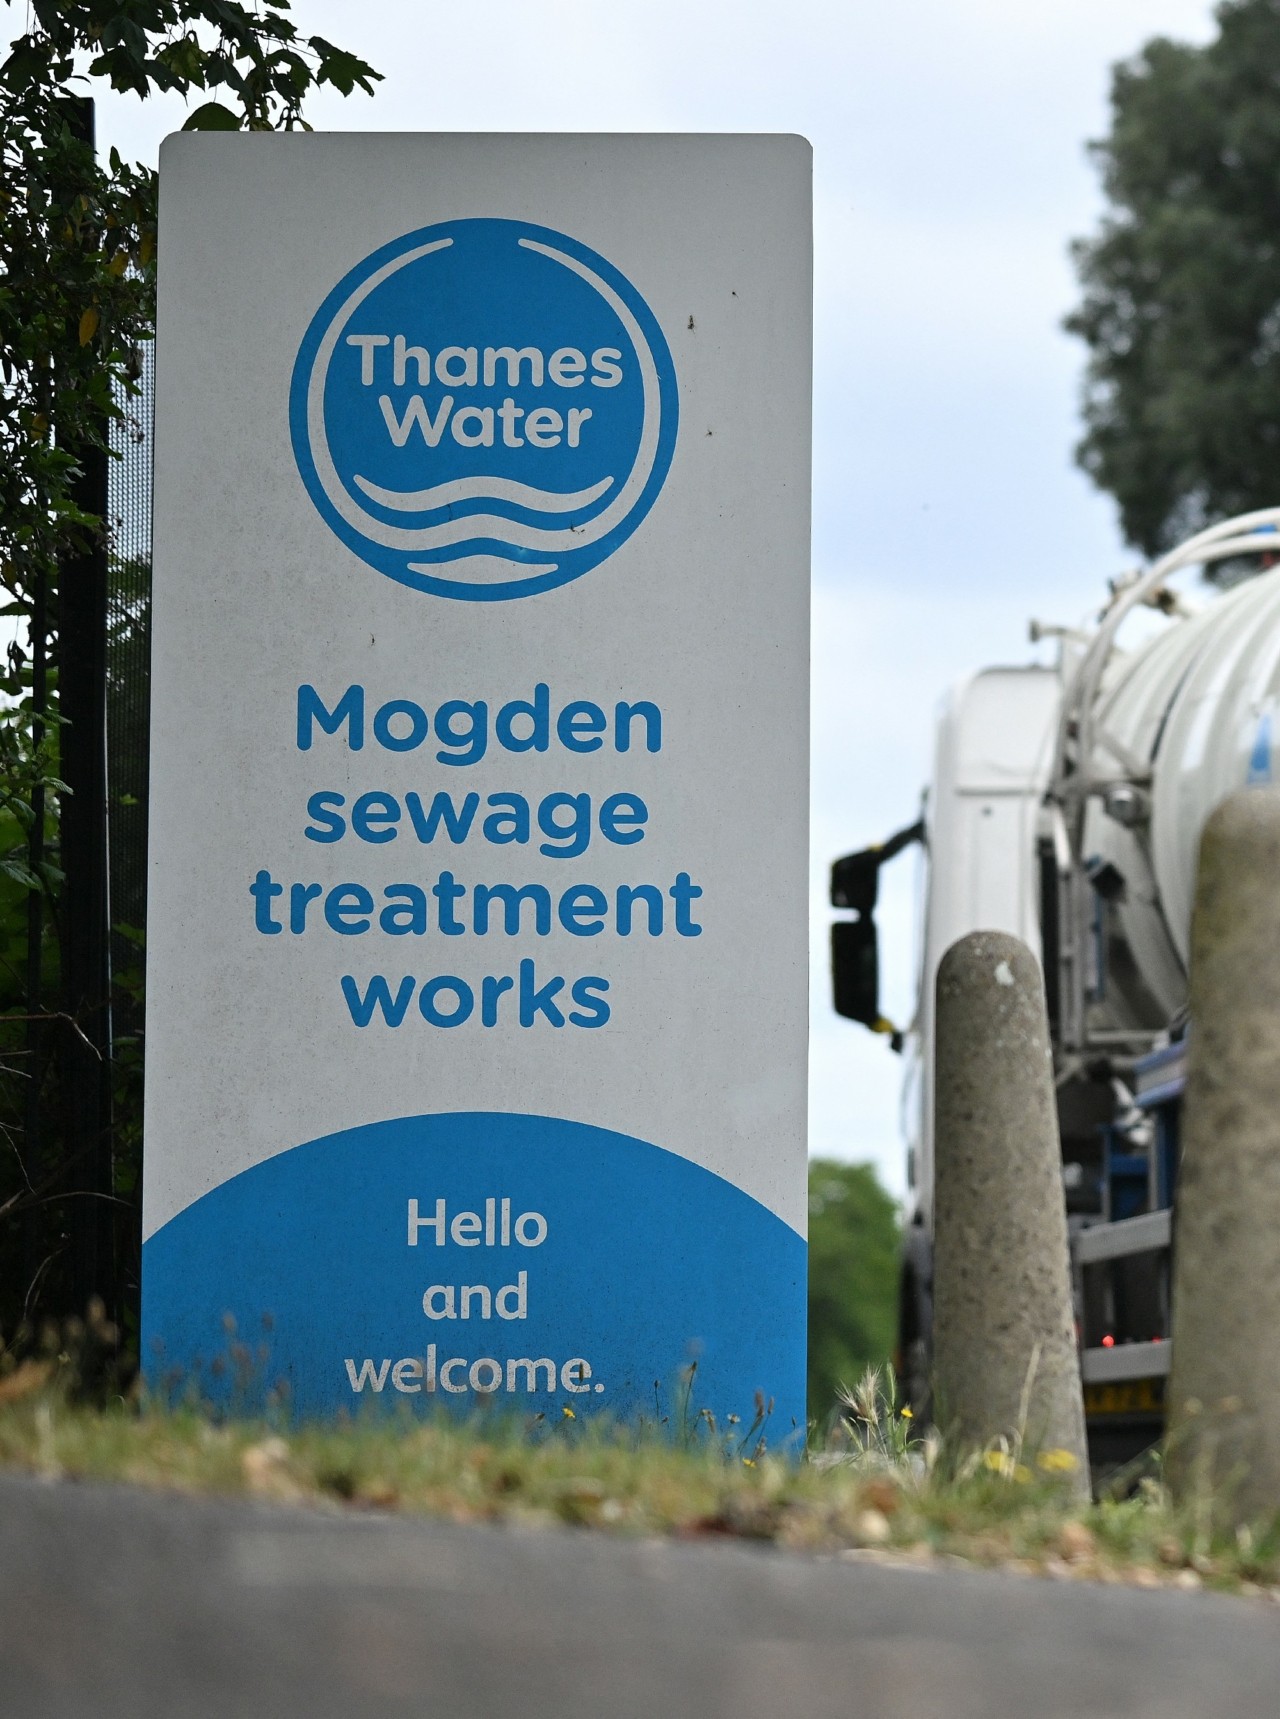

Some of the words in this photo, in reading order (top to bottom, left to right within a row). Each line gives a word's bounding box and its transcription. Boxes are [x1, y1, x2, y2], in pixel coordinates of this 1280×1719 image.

[346, 334, 623, 388] Thames
[379, 394, 593, 448] Water
[297, 683, 662, 767] Mogden
[305, 791, 649, 859] sewage
[250, 870, 703, 937] treatment
[341, 958, 611, 1028] works
[407, 1198, 548, 1247] Hello
[422, 1270, 528, 1320] and
[344, 1344, 605, 1393] welcome.
